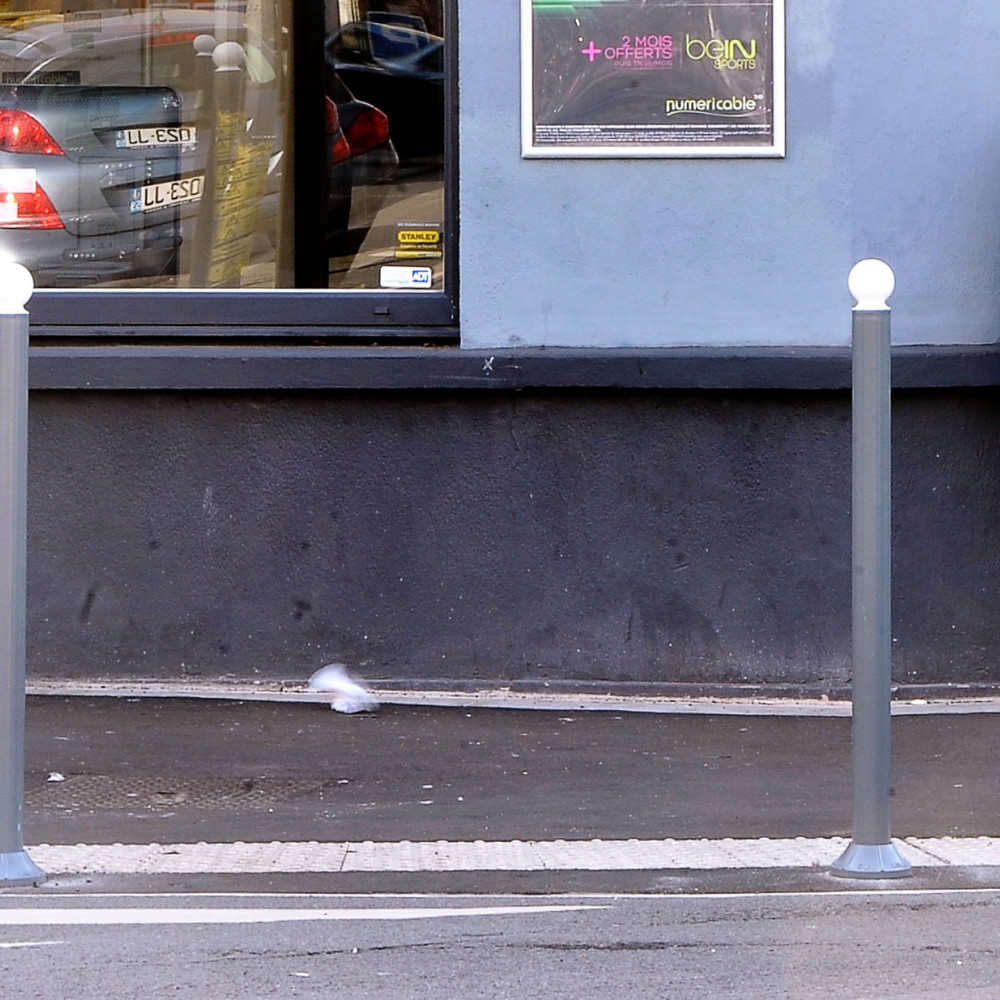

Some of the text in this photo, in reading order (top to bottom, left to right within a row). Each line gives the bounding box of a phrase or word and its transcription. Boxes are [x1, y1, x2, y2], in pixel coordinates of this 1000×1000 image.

[622, 36, 673, 47] 2 MOIS
[604, 47, 673, 60] OFFERTS
[714, 59, 756, 69] SPORTS
[666, 96, 757, 112] numericable
